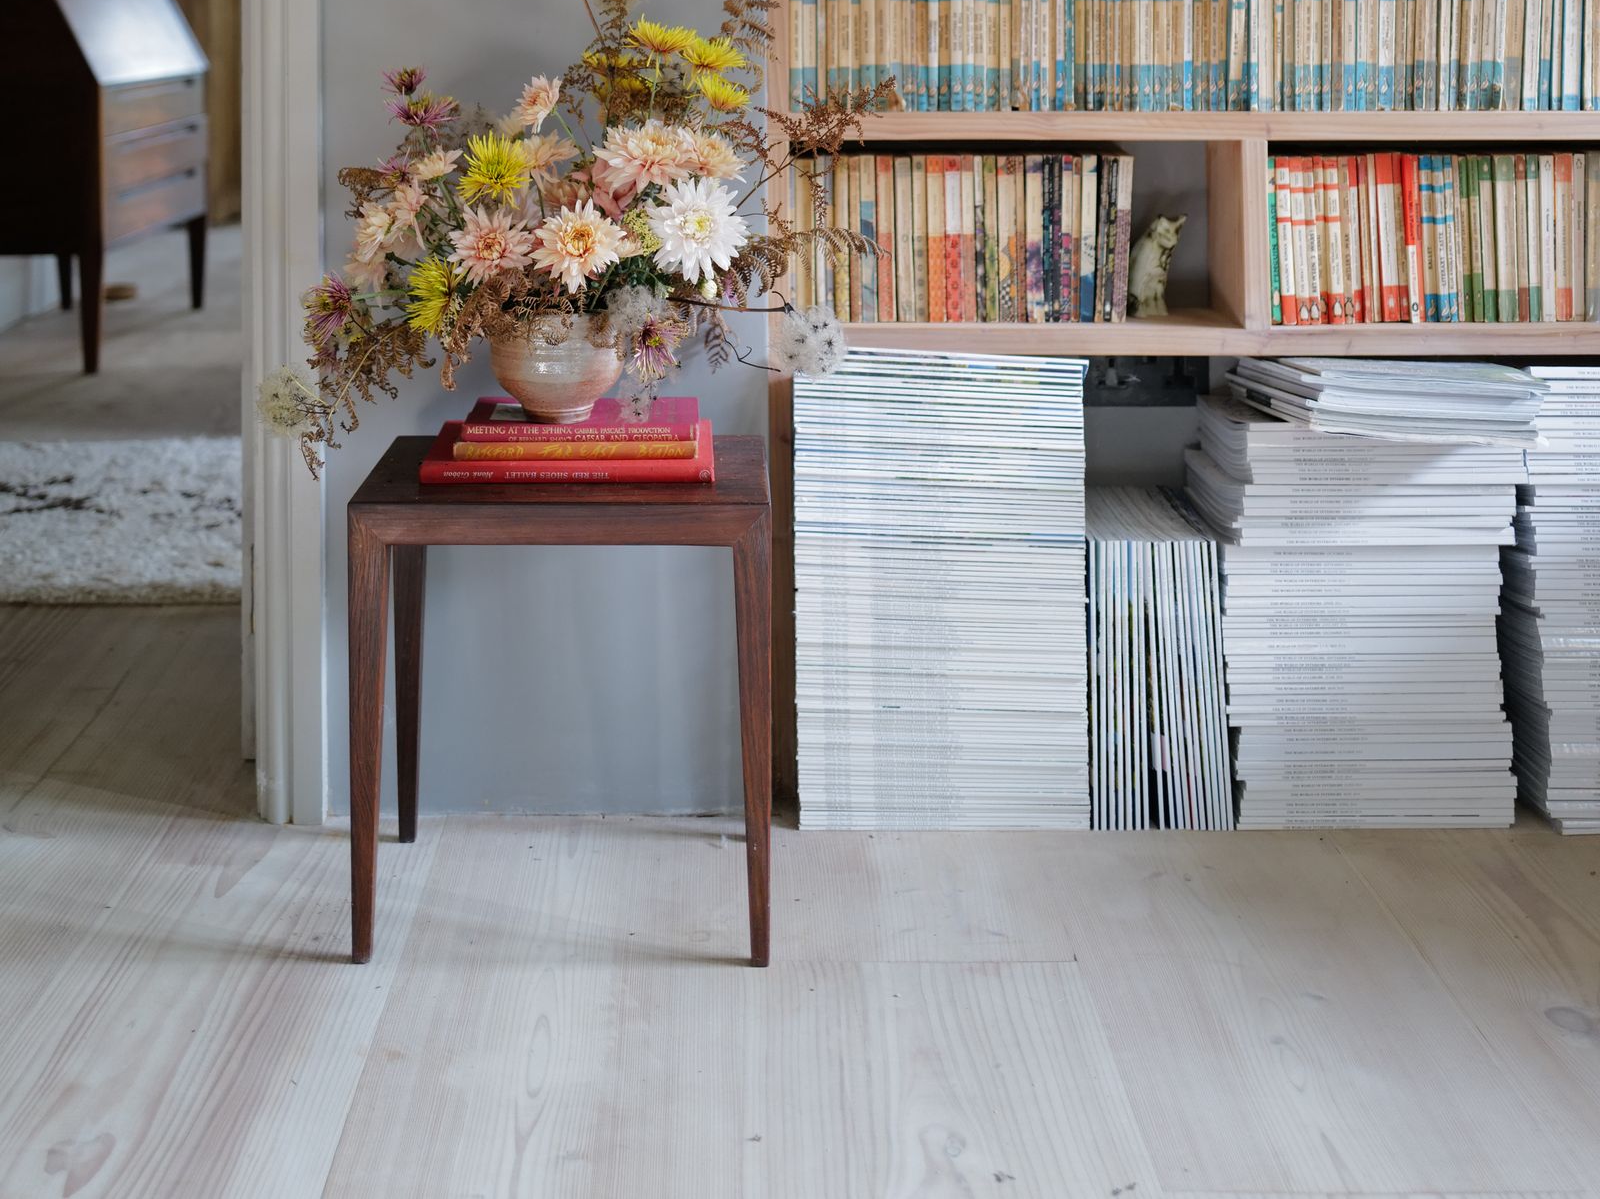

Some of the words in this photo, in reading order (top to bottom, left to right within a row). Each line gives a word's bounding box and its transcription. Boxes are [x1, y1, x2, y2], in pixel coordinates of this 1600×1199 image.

[1271, 244, 1279, 283] PENGUIN
[467, 426, 506, 434] MEETING
[508, 426, 520, 434] AT
[522, 426, 539, 434] THE
[542, 426, 572, 434] SPHINX
[540, 445, 574, 456] FAR
[580, 444, 622, 457] EAST
[638, 444, 685, 456] BEATON
